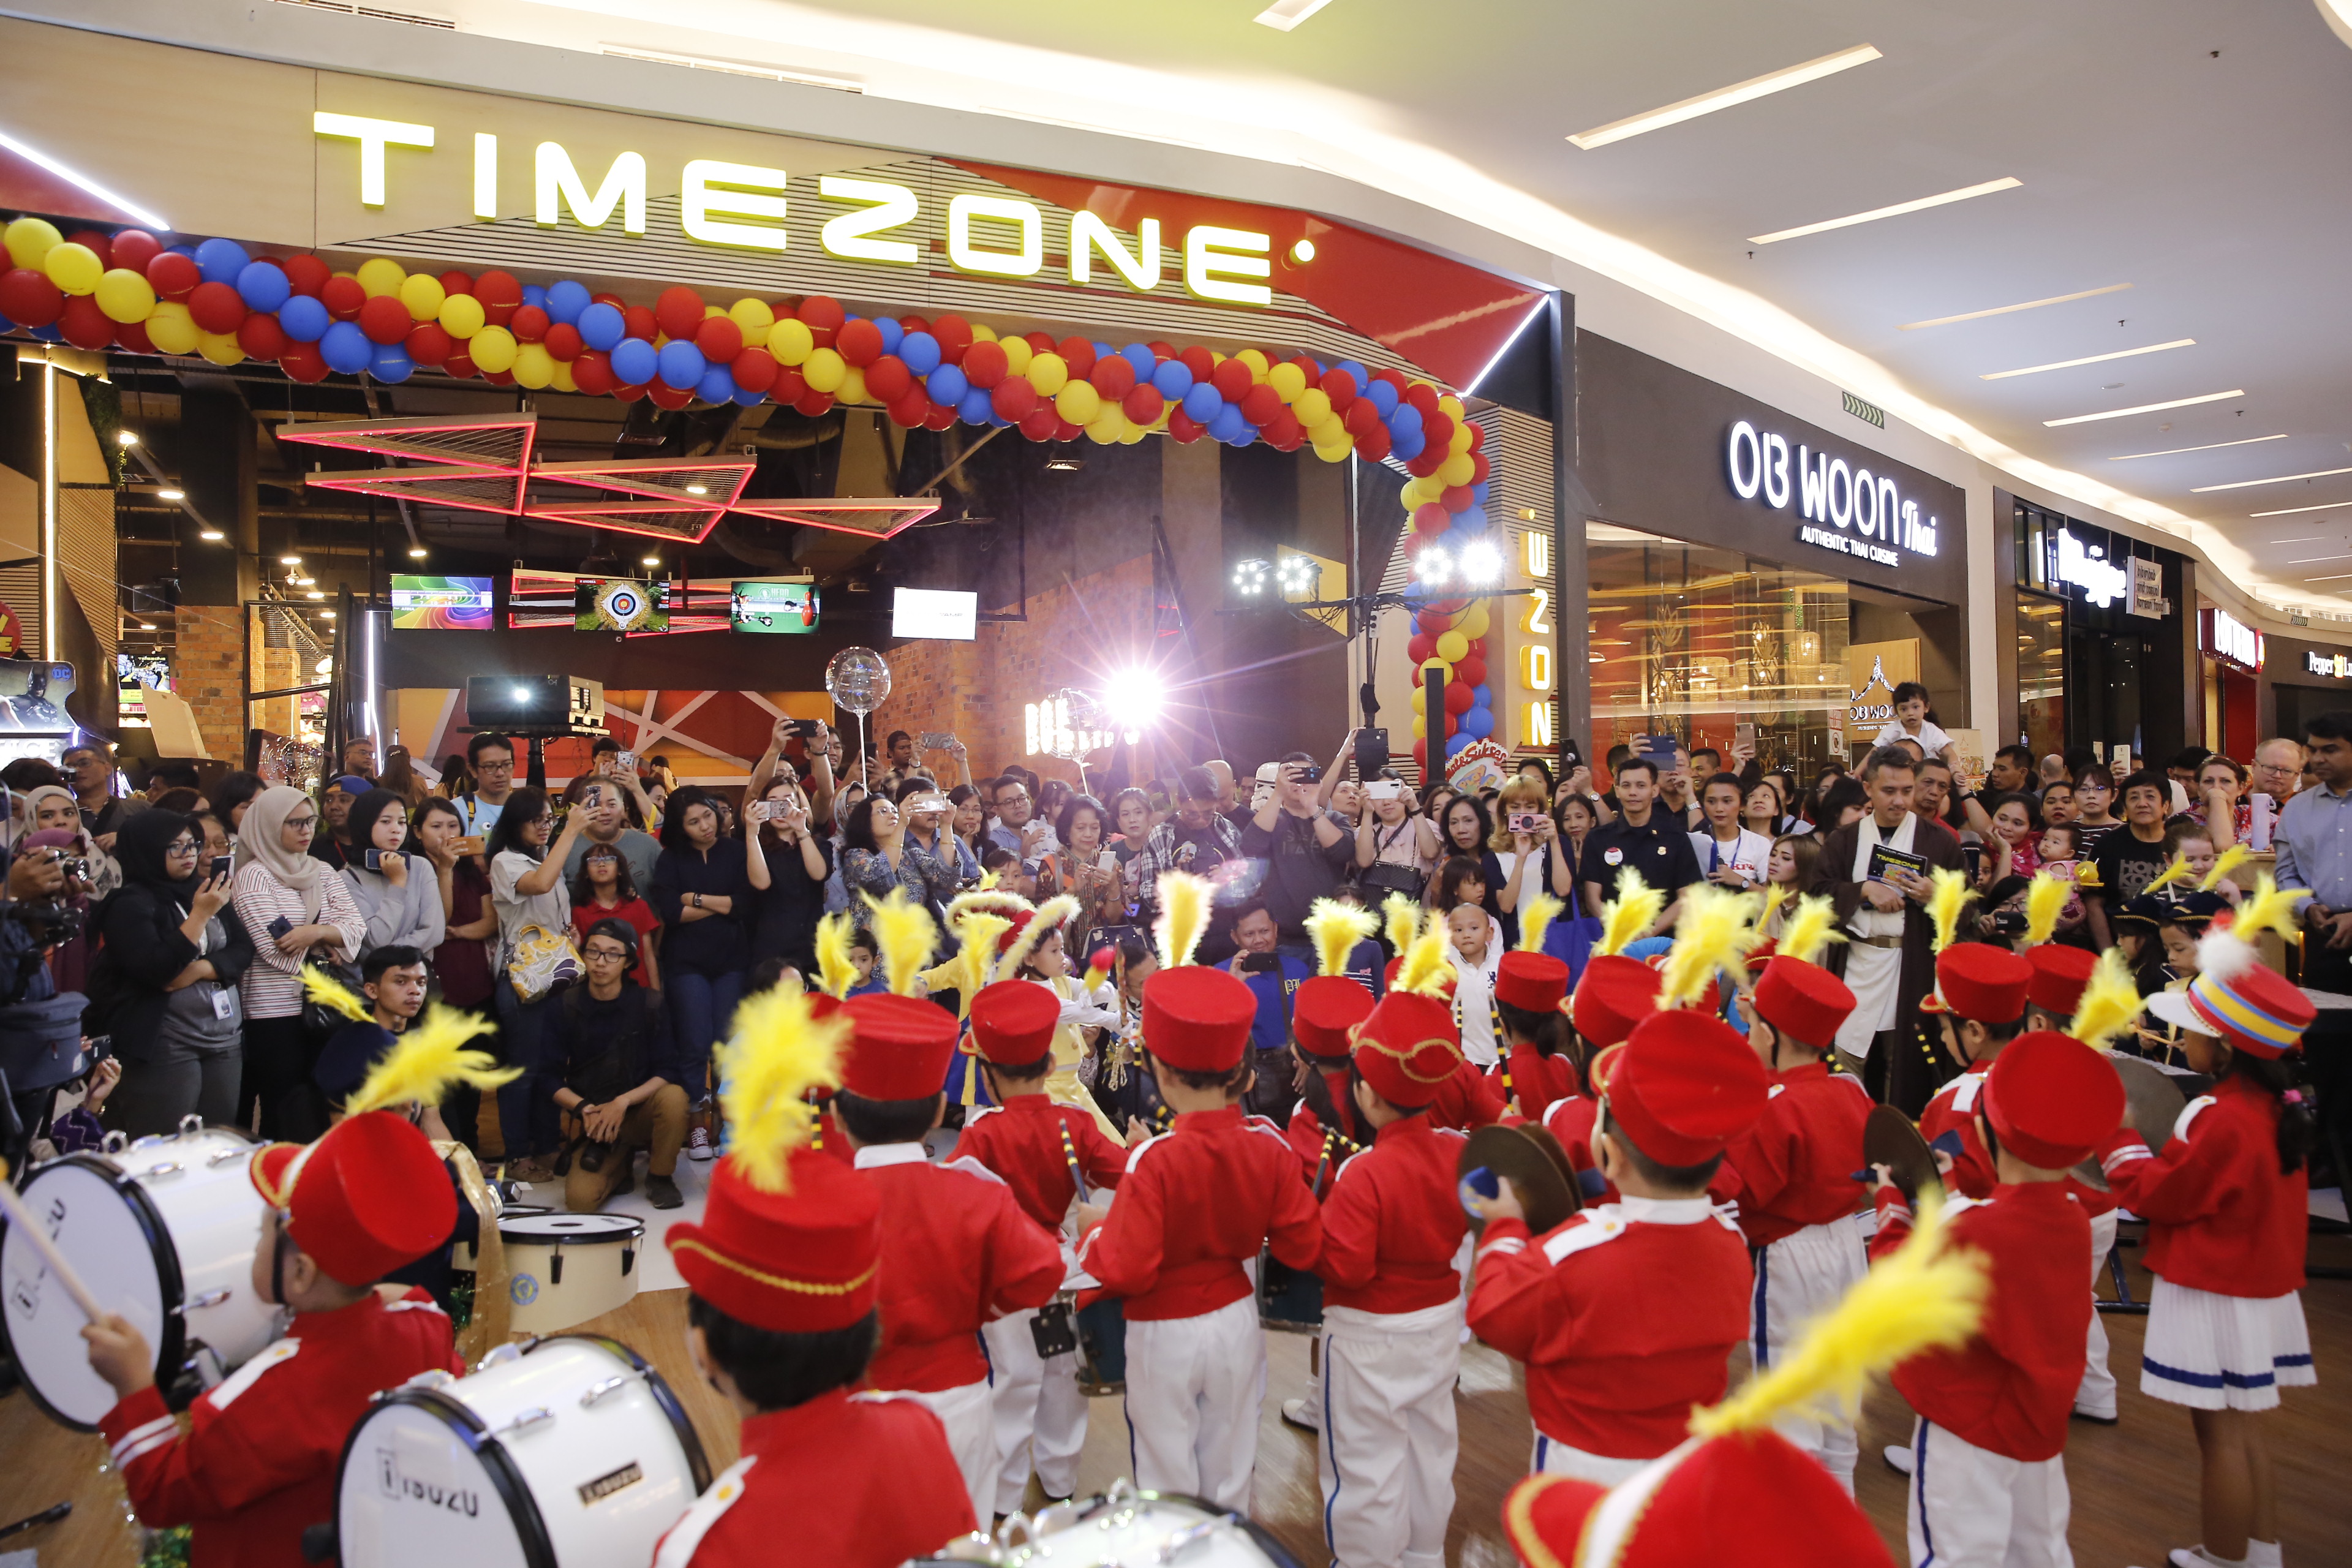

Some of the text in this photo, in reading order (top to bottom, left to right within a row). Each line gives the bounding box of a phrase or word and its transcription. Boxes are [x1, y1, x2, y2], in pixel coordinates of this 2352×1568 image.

[314, 111, 1272, 305] TIMEZONE
[1729, 420, 1790, 509] OB
[1902, 500, 1938, 557] Thai
[1801, 525, 1899, 568] AUTHENTIC THAI CUISINE
[2308, 650, 2334, 676] Pepper
[1464, 742, 1507, 762] Sukses
[1876, 853, 1921, 870] TIMEZONE
